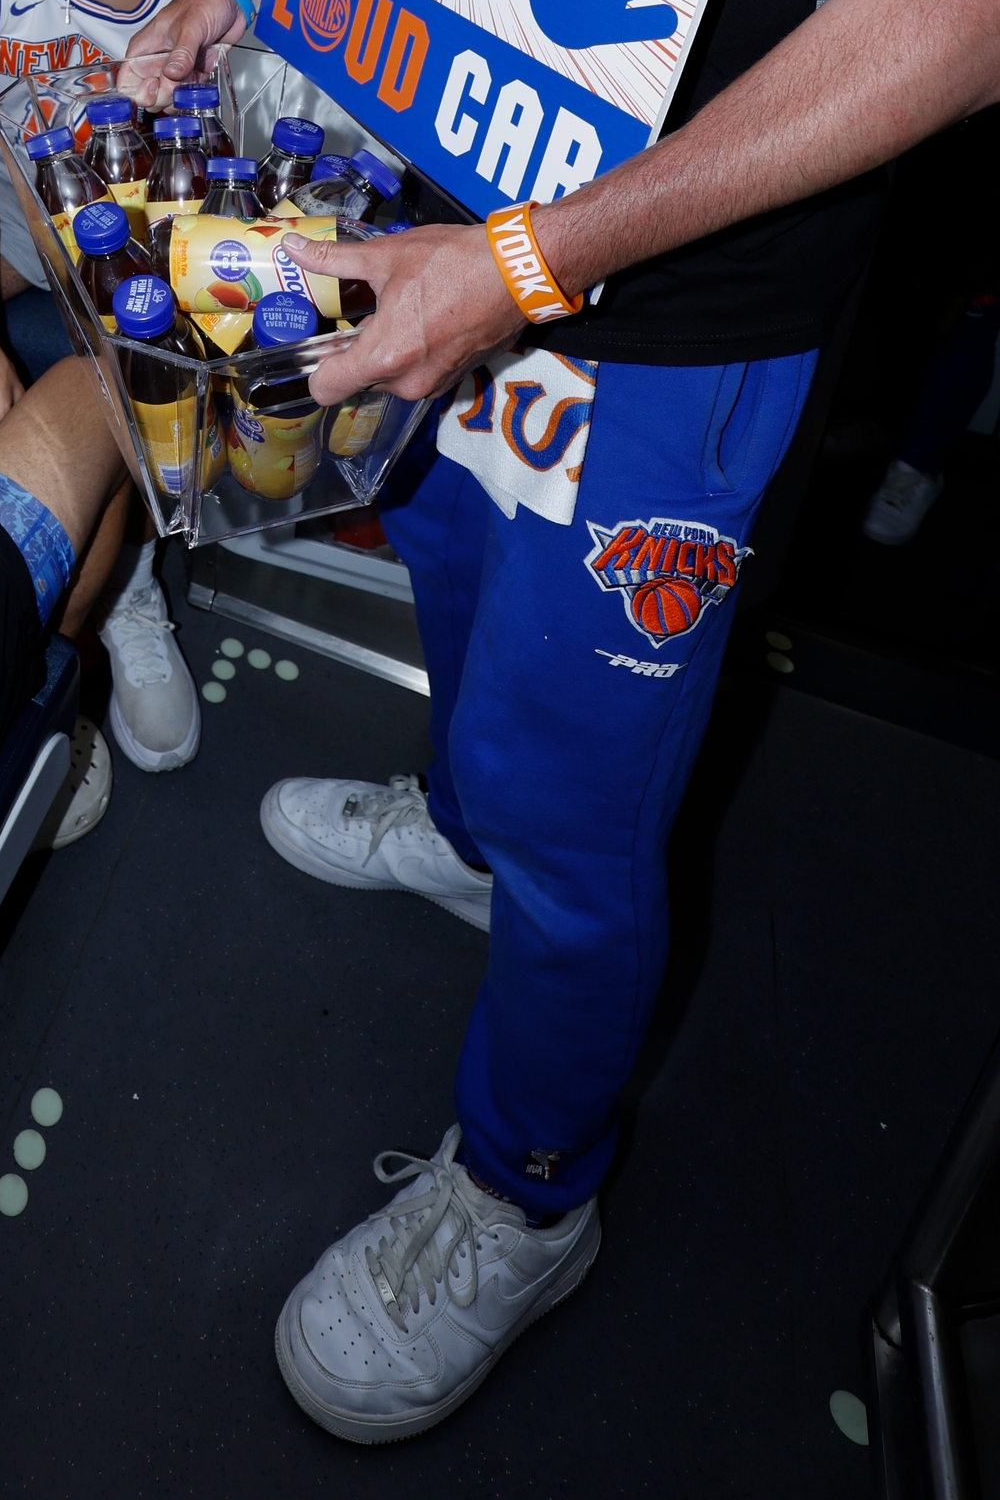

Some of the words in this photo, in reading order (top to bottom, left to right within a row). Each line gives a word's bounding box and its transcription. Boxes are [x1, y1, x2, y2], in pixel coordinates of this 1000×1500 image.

[434, 48, 603, 204] CAR
[88, 206, 102, 217] TIME
[99, 215, 114, 226] FUN
[231, 251, 239, 271] Real
[491, 213, 554, 301] YORK
[130, 281, 138, 296] EVERY
[137, 279, 147, 292] FUN
[126, 298, 135, 310] TIME
[132, 295, 145, 313] TIME
[263, 312, 282, 320] FUN
[285, 313, 308, 324] TIME
[289, 322, 305, 330] TIME
[650, 522, 684, 537] NEW
[683, 528, 715, 546] YORK
[593, 527, 736, 587] KNICKS
